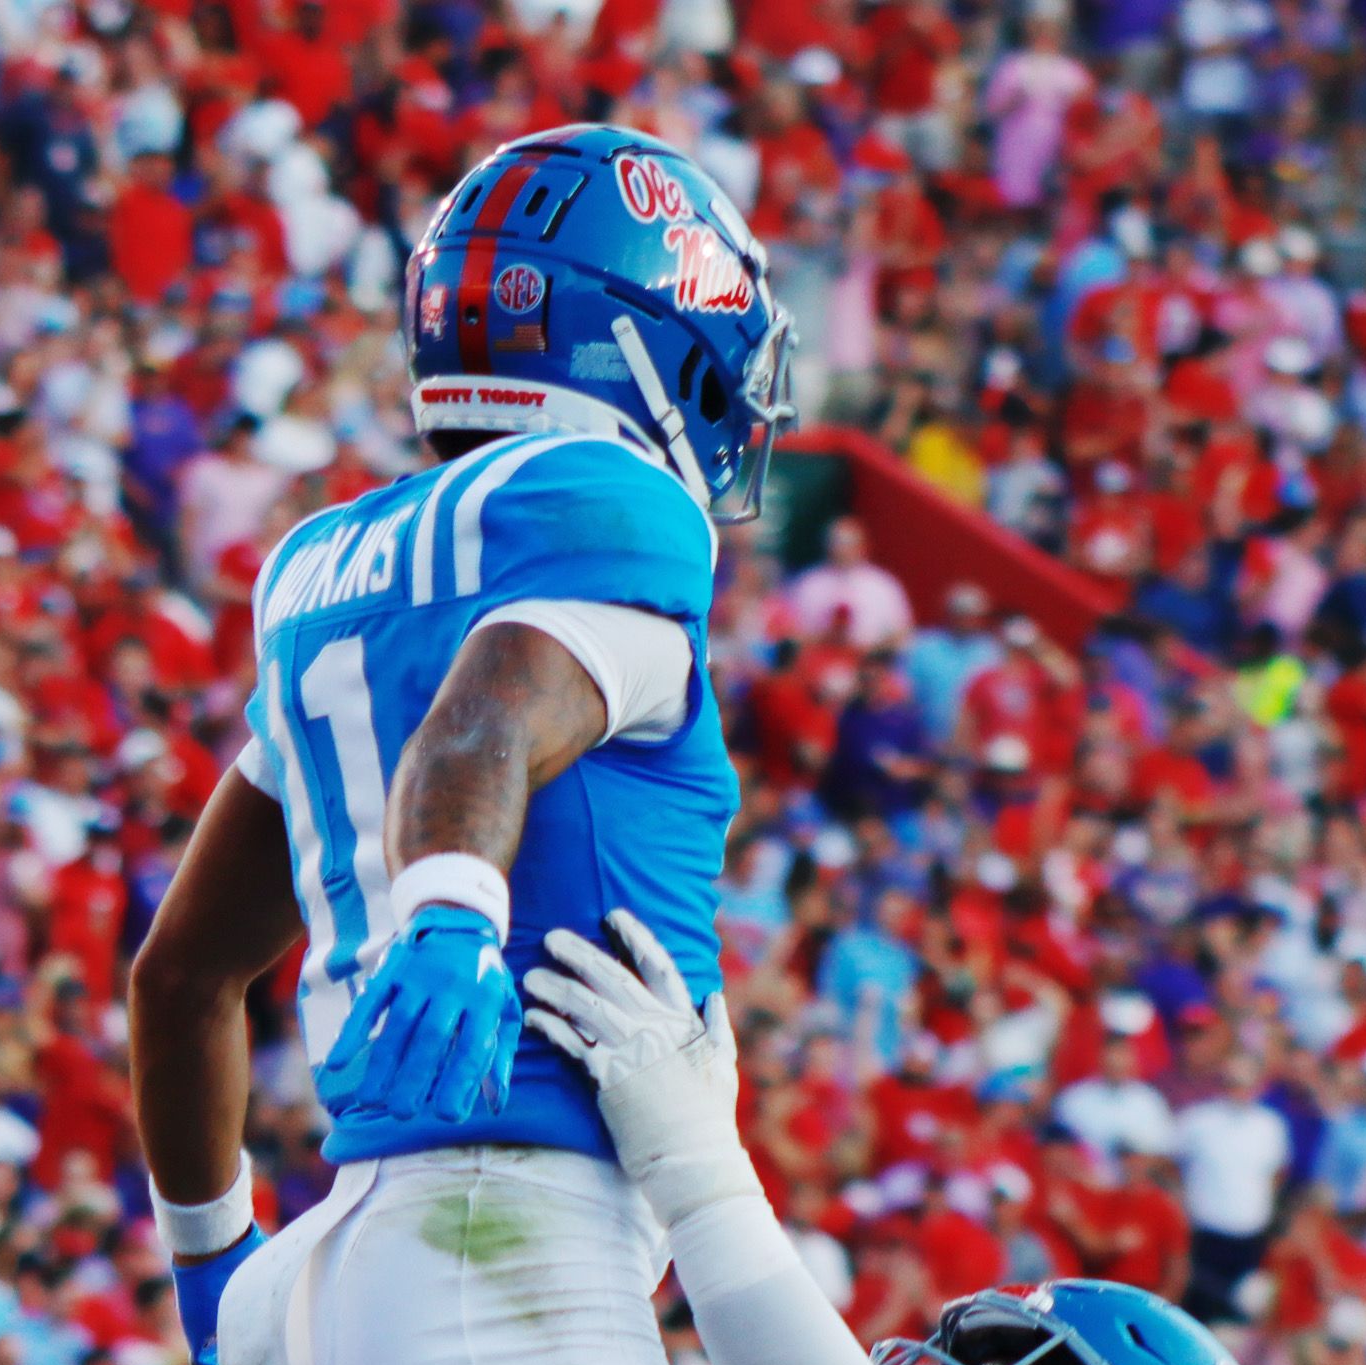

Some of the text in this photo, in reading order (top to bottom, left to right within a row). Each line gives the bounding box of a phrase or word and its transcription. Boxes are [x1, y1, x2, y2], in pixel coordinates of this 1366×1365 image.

[615, 154, 693, 224] Ole
[497, 266, 543, 311] SEC
[477, 389, 546, 407] TODDY
[265, 635, 400, 1066] 11
